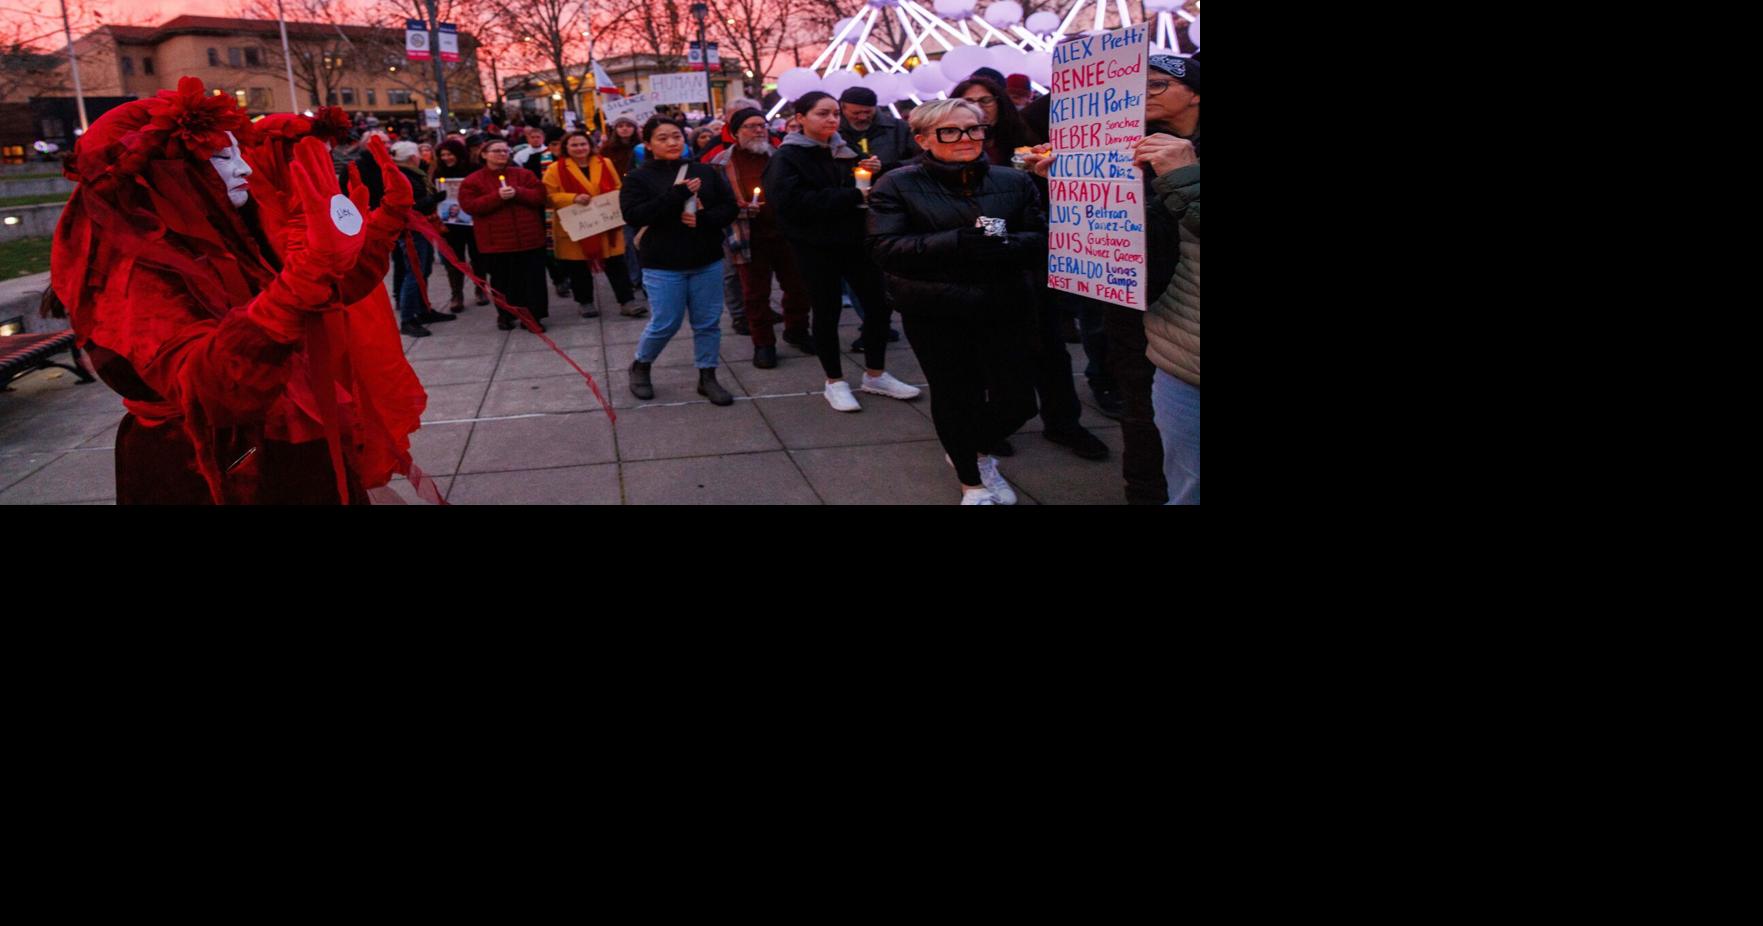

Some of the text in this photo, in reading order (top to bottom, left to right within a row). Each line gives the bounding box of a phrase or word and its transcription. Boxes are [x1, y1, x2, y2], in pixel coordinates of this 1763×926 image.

[1053, 28, 1145, 64] ALEX Pretti
[652, 75, 703, 91] HUMAN
[1052, 53, 1141, 94] RENEE Good
[1051, 87, 1143, 124] KEITH Porter
[1050, 122, 1102, 149] HEBER
[1050, 153, 1106, 178] VICTOR
[1050, 180, 1137, 209] PARADY La
[1050, 204, 1081, 226] LUIS
[1049, 232, 1083, 253] LUIS
[1049, 254, 1103, 279] GERALDO
[1048, 275, 1138, 305] REST IN PEACE
